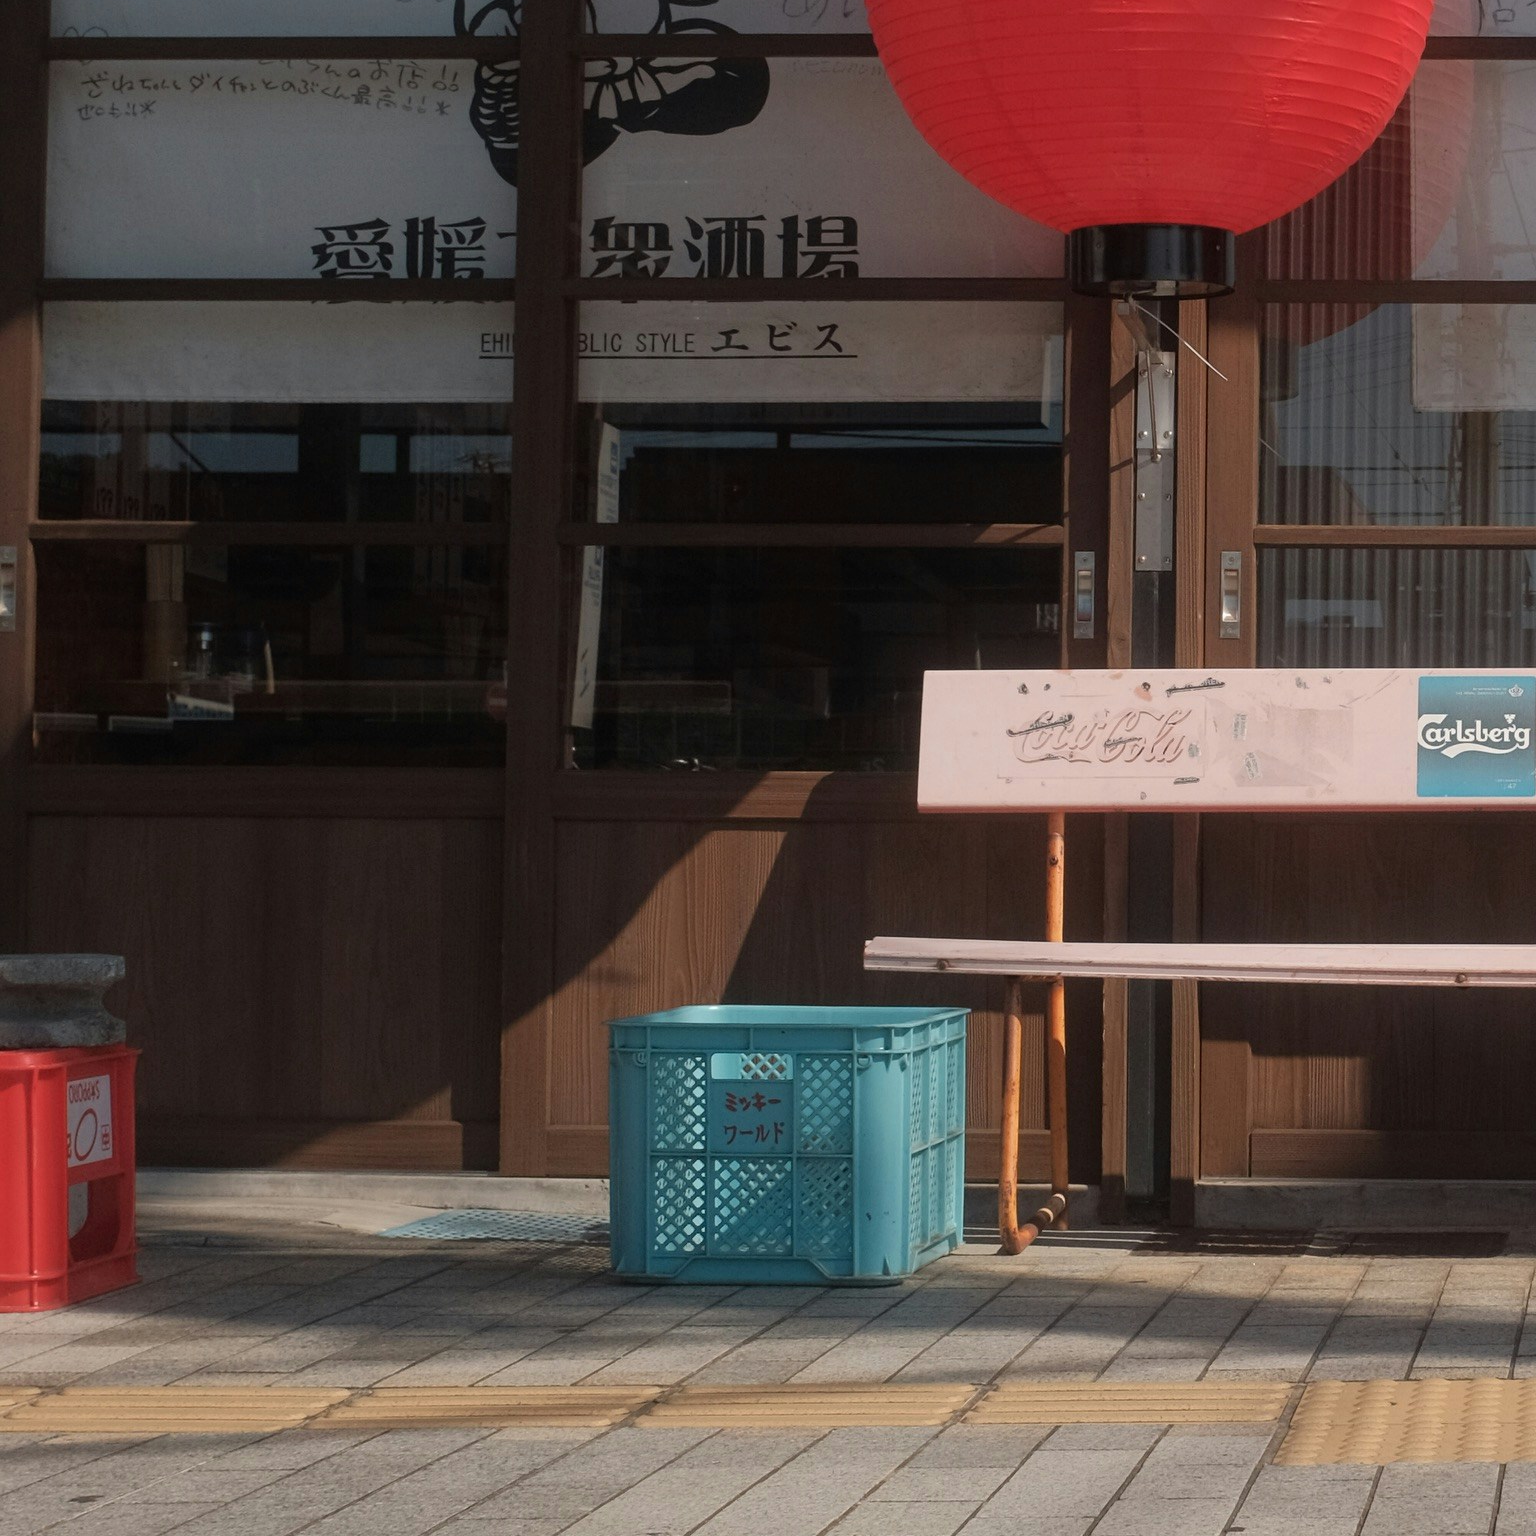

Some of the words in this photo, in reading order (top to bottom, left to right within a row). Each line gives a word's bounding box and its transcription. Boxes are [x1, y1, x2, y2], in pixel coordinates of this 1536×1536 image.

[310, 215, 860, 303] 愛媛衆酒場
[635, 332, 695, 353] STYLE
[710, 321, 843, 353] エビス
[1417, 713, 1531, 758] Carlsberg
[724, 1092, 782, 1114] ミッキー
[723, 1121, 786, 1155] ワールド
